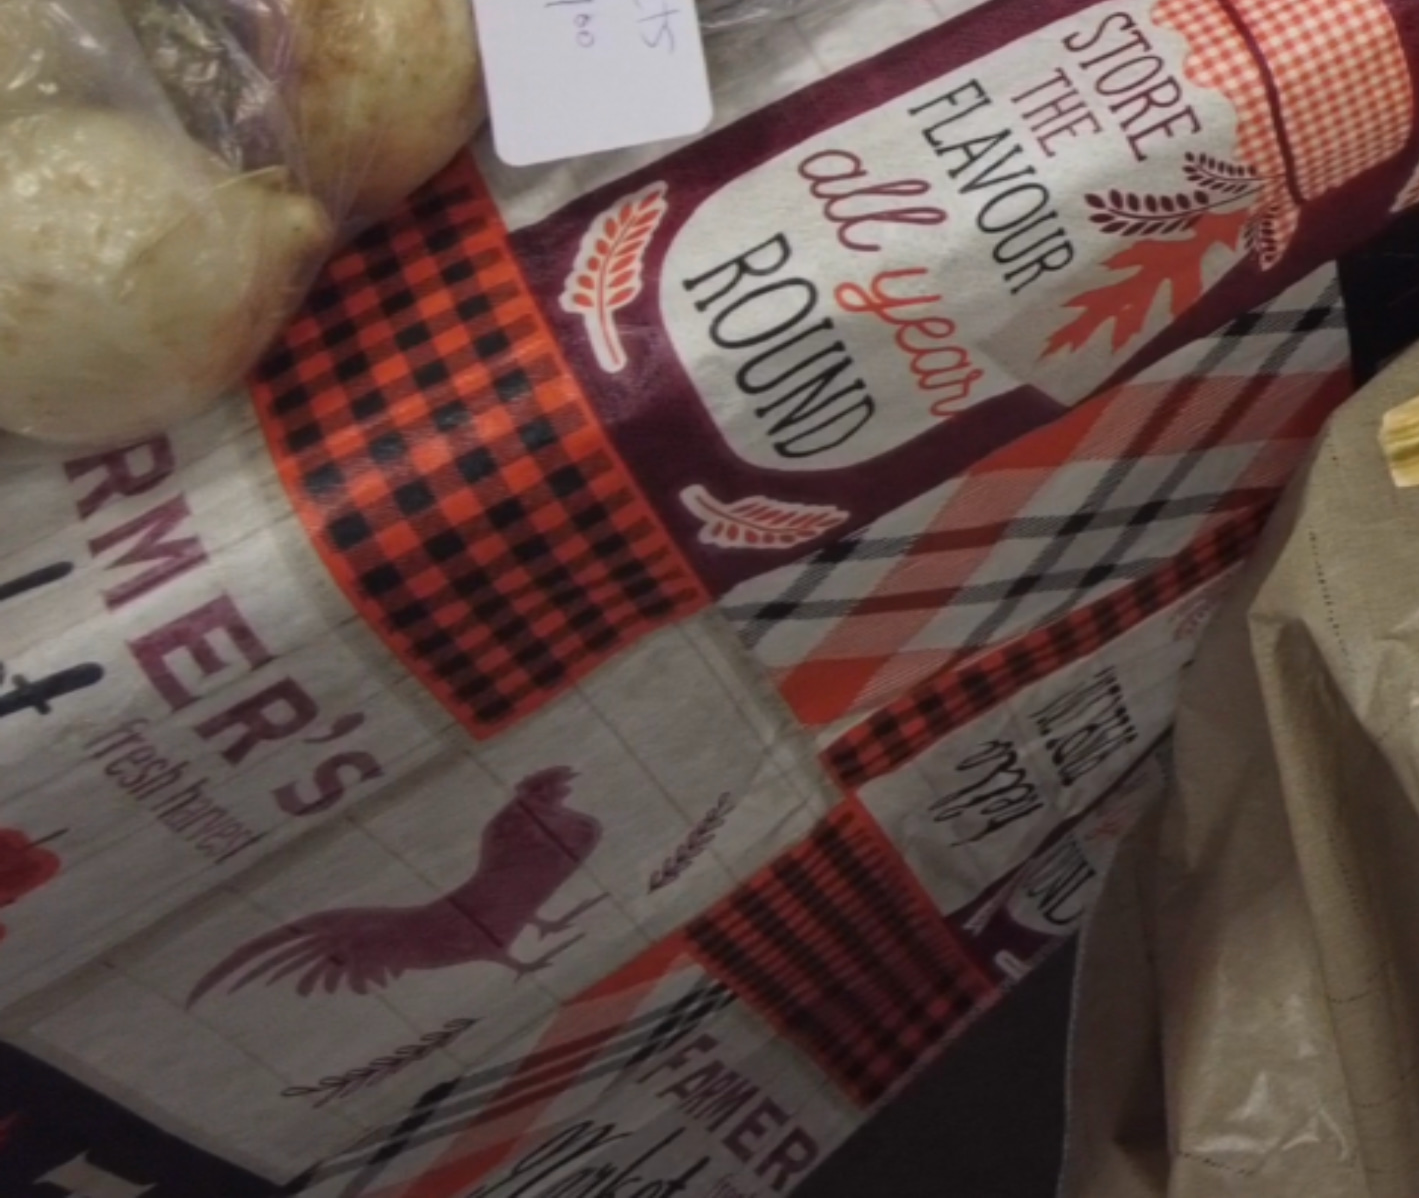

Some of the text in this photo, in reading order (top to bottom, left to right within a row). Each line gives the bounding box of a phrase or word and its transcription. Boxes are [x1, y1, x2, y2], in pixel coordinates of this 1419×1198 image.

[907, 78, 1075, 296] FLAVOUR
[1010, 67, 1104, 158] THE
[1061, 11, 1201, 163] STORE
[682, 232, 877, 460] ROUND
[797, 148, 985, 419] all year
[63, 432, 384, 818] RMER'S
